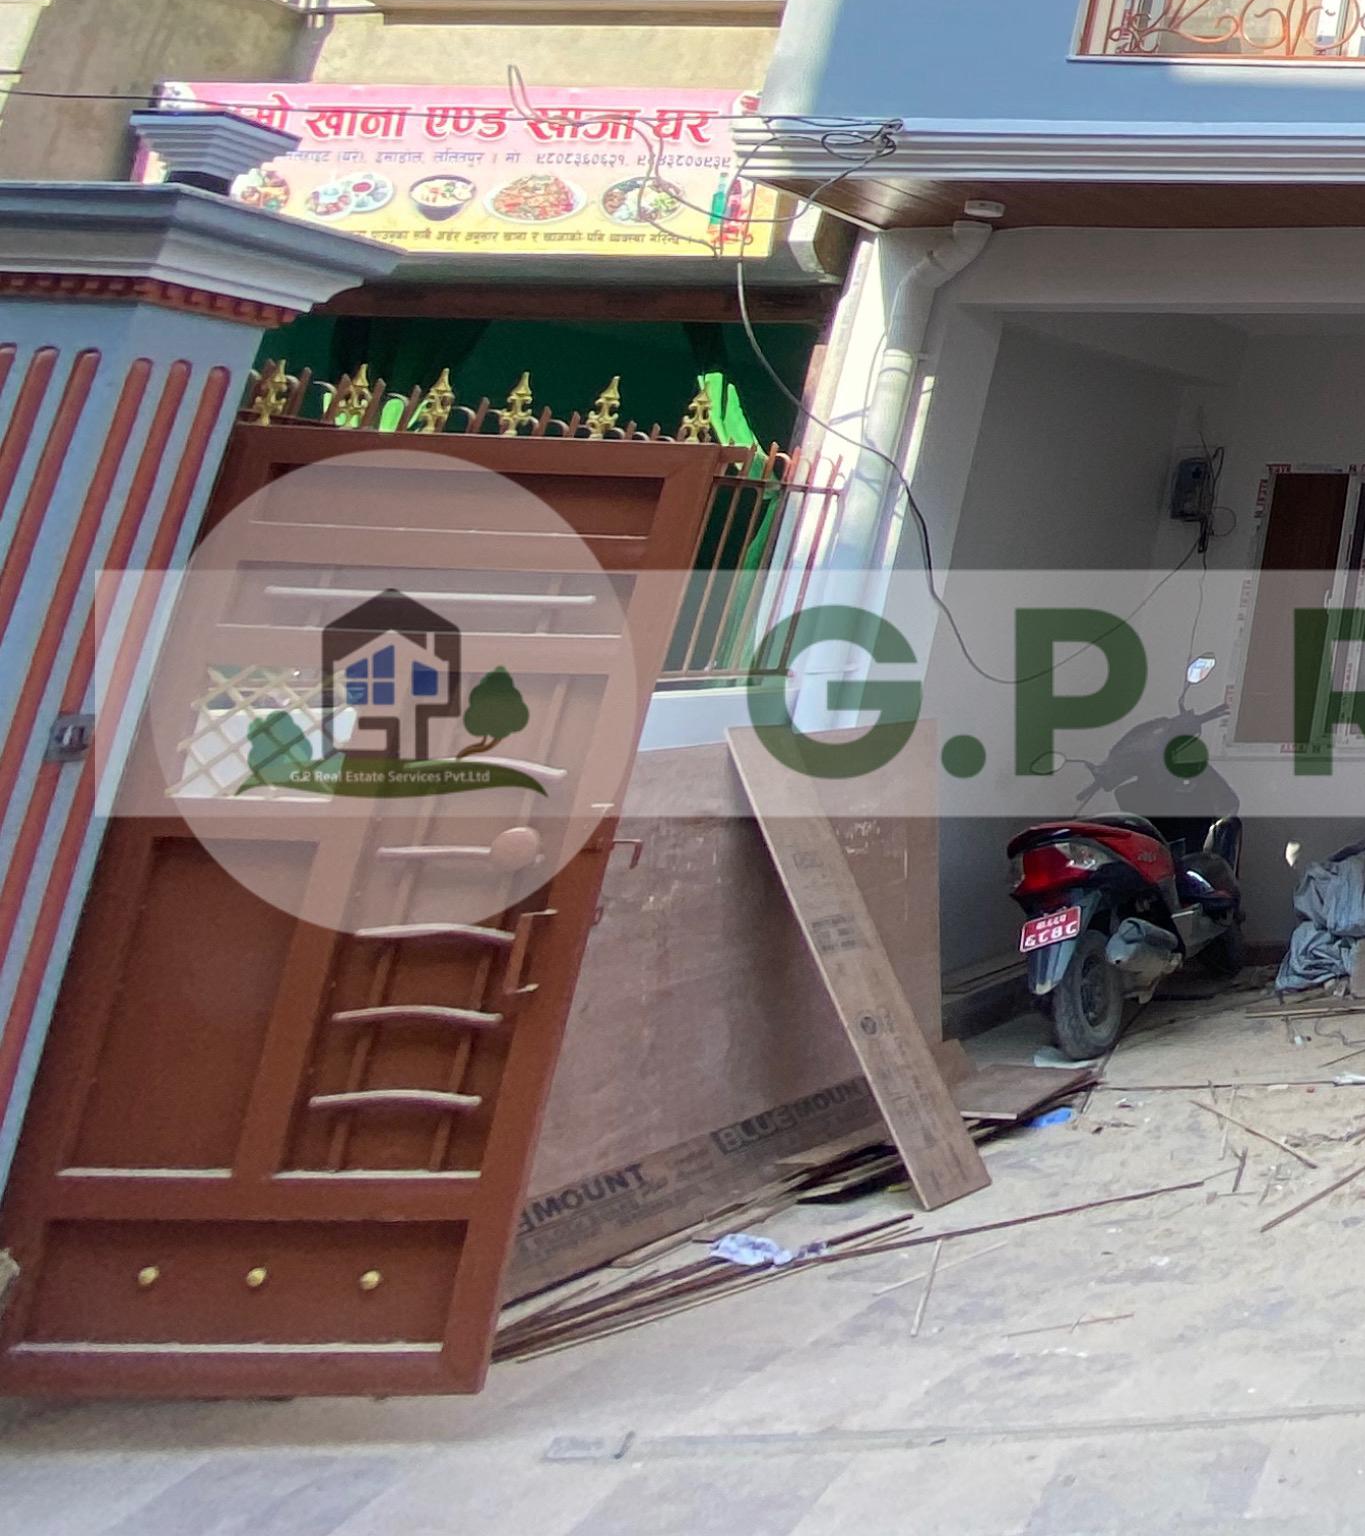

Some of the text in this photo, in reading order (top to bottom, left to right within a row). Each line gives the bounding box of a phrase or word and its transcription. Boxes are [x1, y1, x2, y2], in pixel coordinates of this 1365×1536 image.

[306, 106, 412, 138] खाना
[425, 107, 514, 138] एण्ड
[526, 108, 642, 141] खाजा
[652, 109, 719, 143] घर
